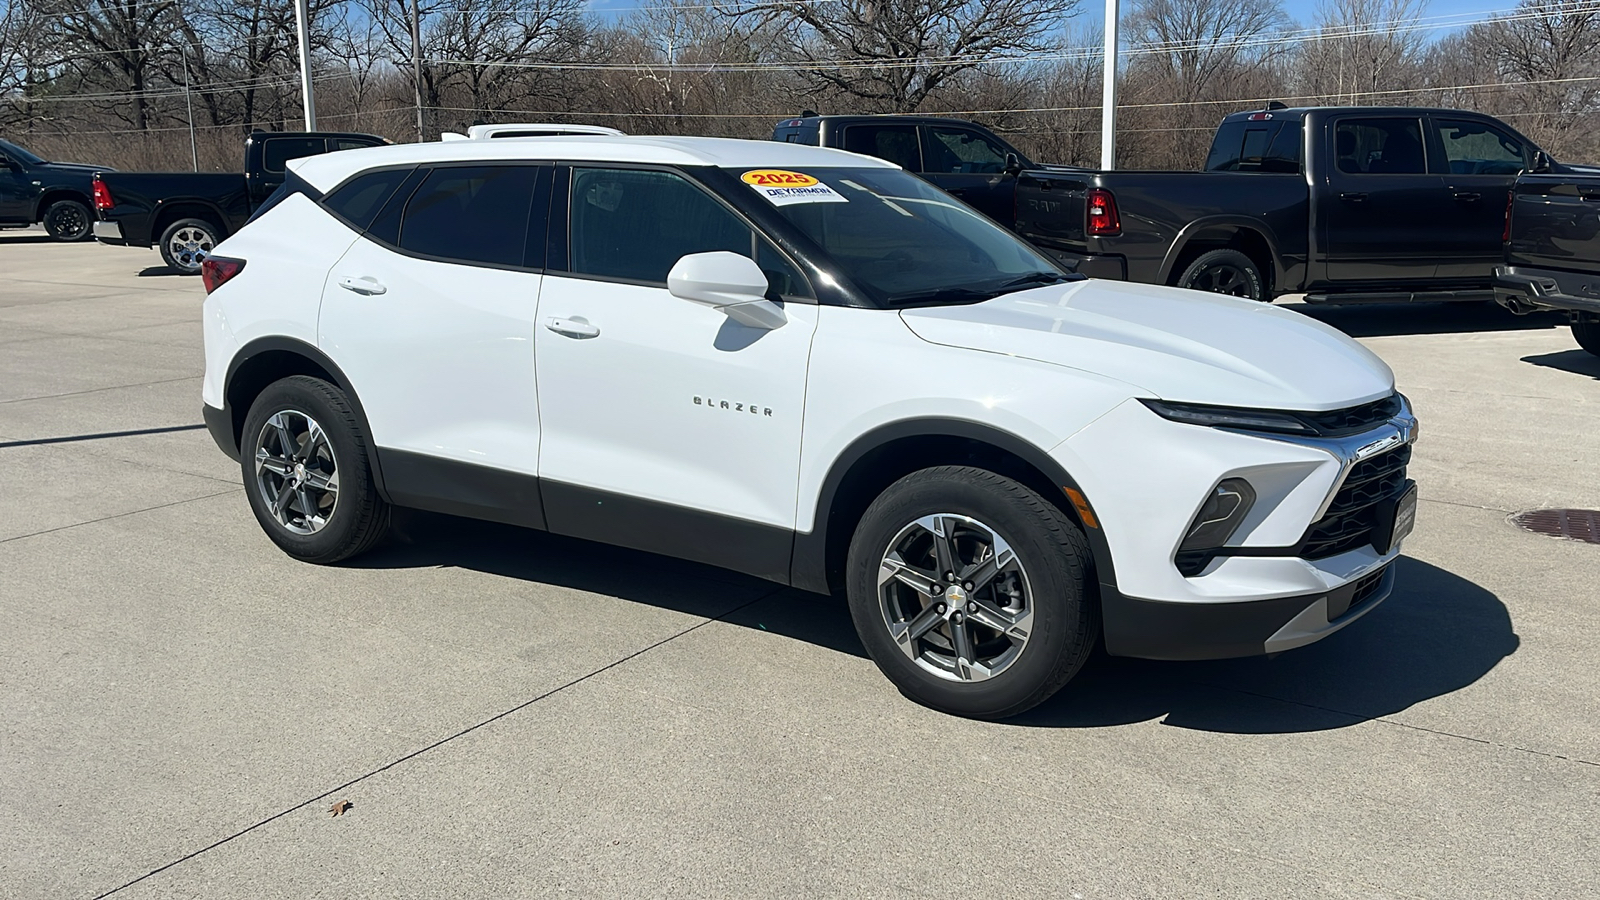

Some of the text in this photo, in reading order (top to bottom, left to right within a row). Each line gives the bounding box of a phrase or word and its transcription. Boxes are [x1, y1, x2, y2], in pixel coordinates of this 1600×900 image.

[752, 173, 811, 185] 2025
[766, 187, 832, 197] DEYARMAN
[693, 396, 773, 417] BLAZER
